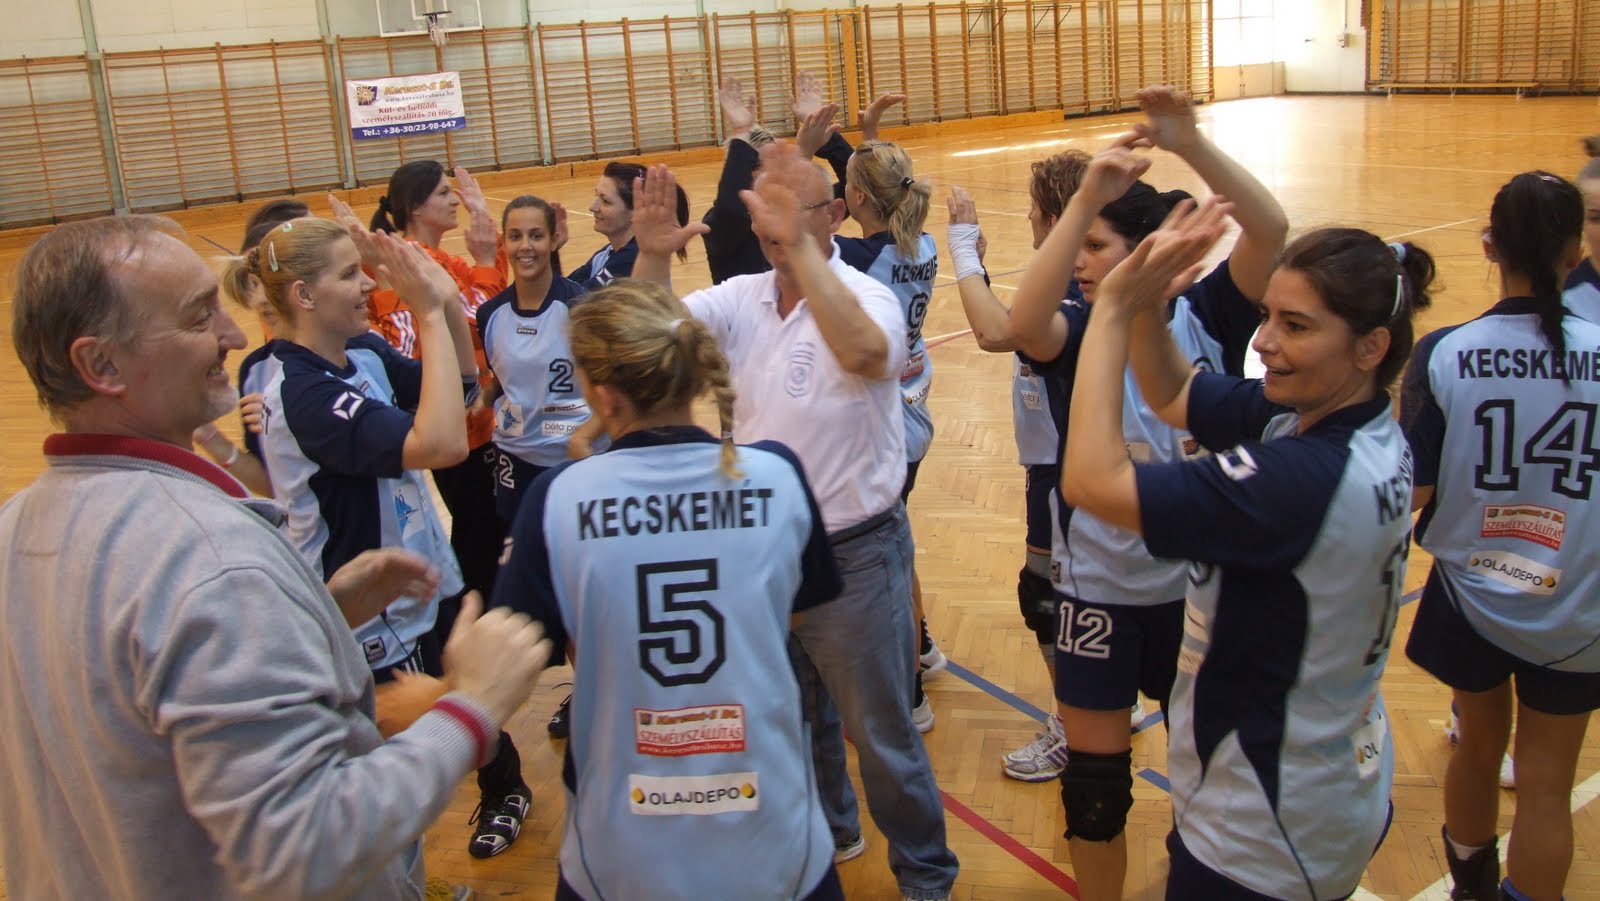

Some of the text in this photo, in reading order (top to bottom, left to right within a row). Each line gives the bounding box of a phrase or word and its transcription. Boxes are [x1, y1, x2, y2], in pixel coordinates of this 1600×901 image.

[362, 112, 425, 124] személyszállítás
[397, 105, 406, 113] és
[408, 102, 438, 112] belföldi
[362, 120, 456, 137] Tel.: +36-30/23-98-647
[549, 358, 574, 392] 2
[1474, 399, 1600, 500] 14
[577, 479, 775, 540] KECSKEMÉT
[1484, 518, 1562, 540] SZEMÉLYSZÁLLÍTÁS
[1482, 558, 1543, 586] OLAJDEPO
[635, 558, 726, 687] 5
[1057, 601, 1113, 659] 12
[640, 724, 743, 745] SZEMÉLYSZÁLLÍTÁS
[649, 787, 740, 805] OLAJDEPO
